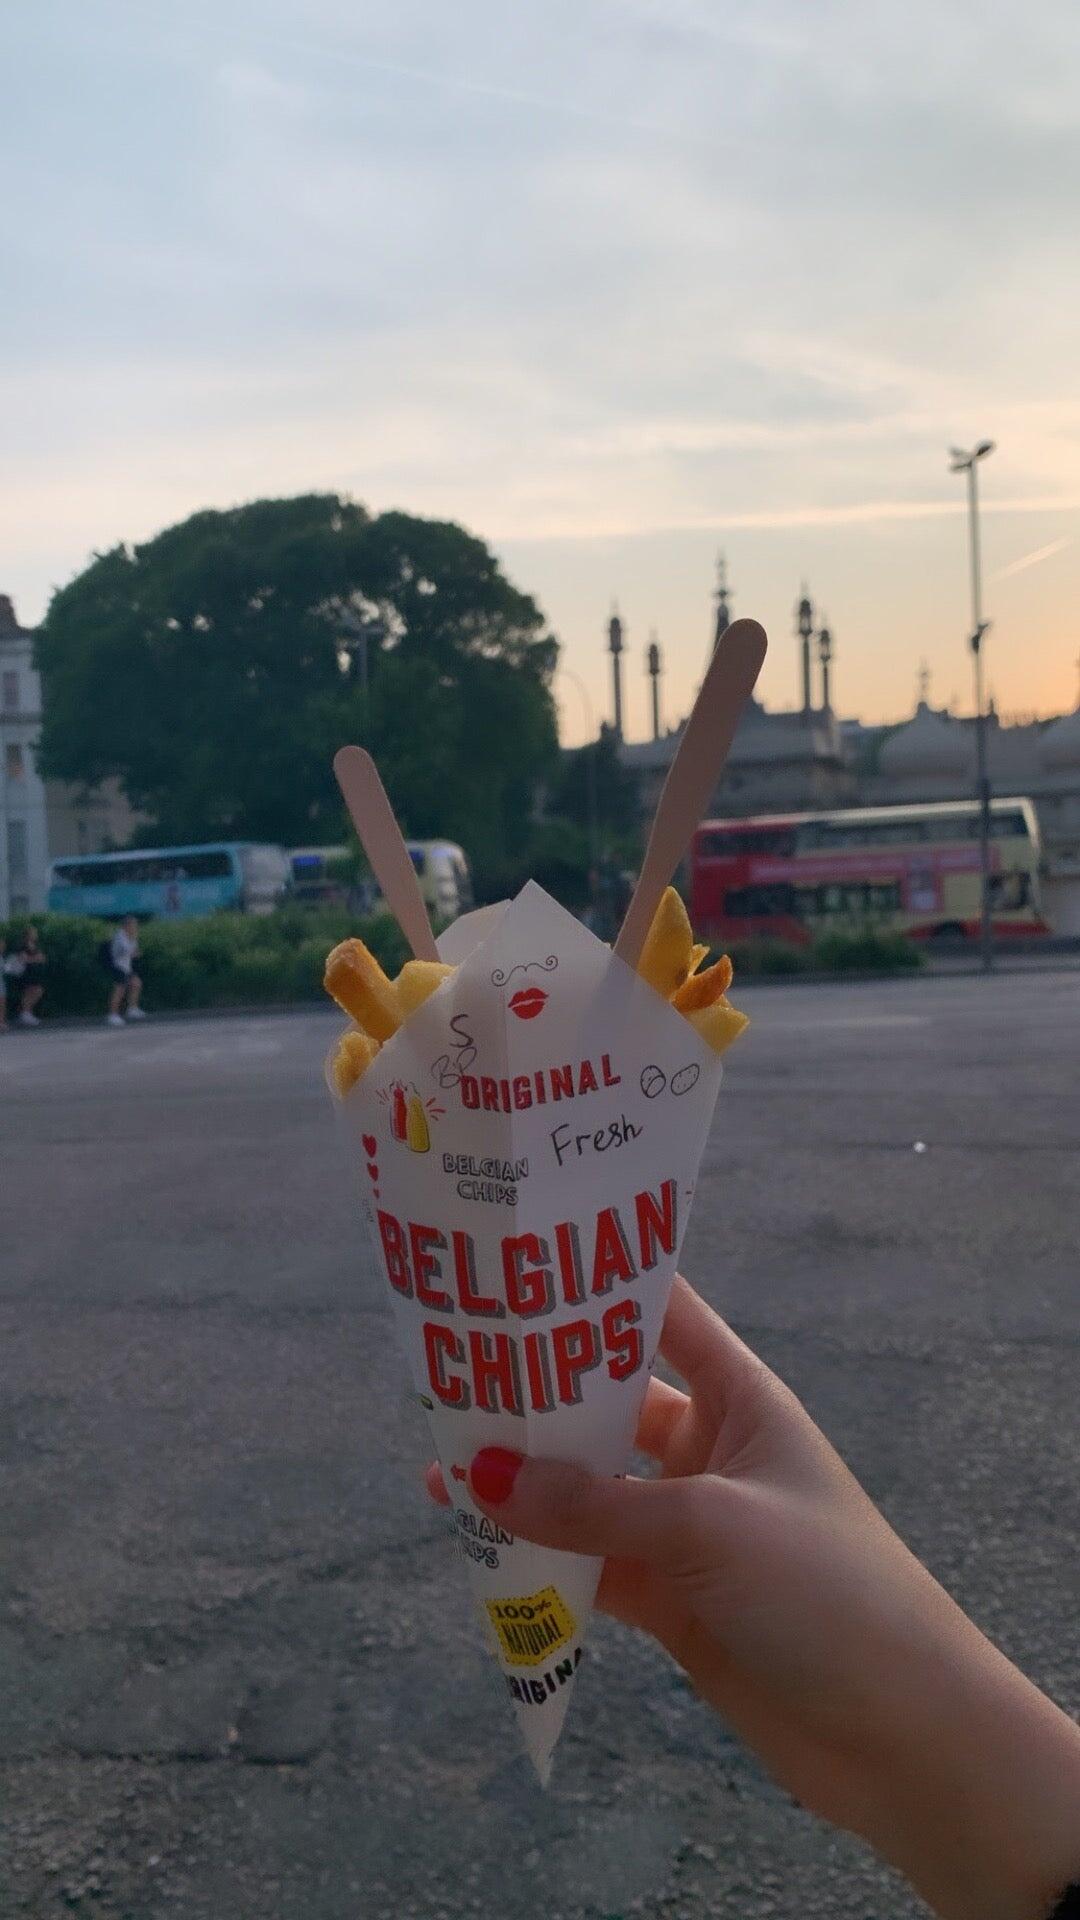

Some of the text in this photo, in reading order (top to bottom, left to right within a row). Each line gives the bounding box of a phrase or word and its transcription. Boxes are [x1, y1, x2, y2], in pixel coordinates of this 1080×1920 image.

[460, 1054, 622, 1114] ORIGINAL
[550, 1114, 643, 1168] Fresh
[443, 1152, 530, 1182] BELGIAN
[457, 1180, 519, 1206] CHIPS
[377, 1179, 678, 1320] BELGIAN
[423, 1299, 644, 1418] CHIPS
[494, 1600, 553, 1620] 100%
[501, 1613, 565, 1657] NATURAL
